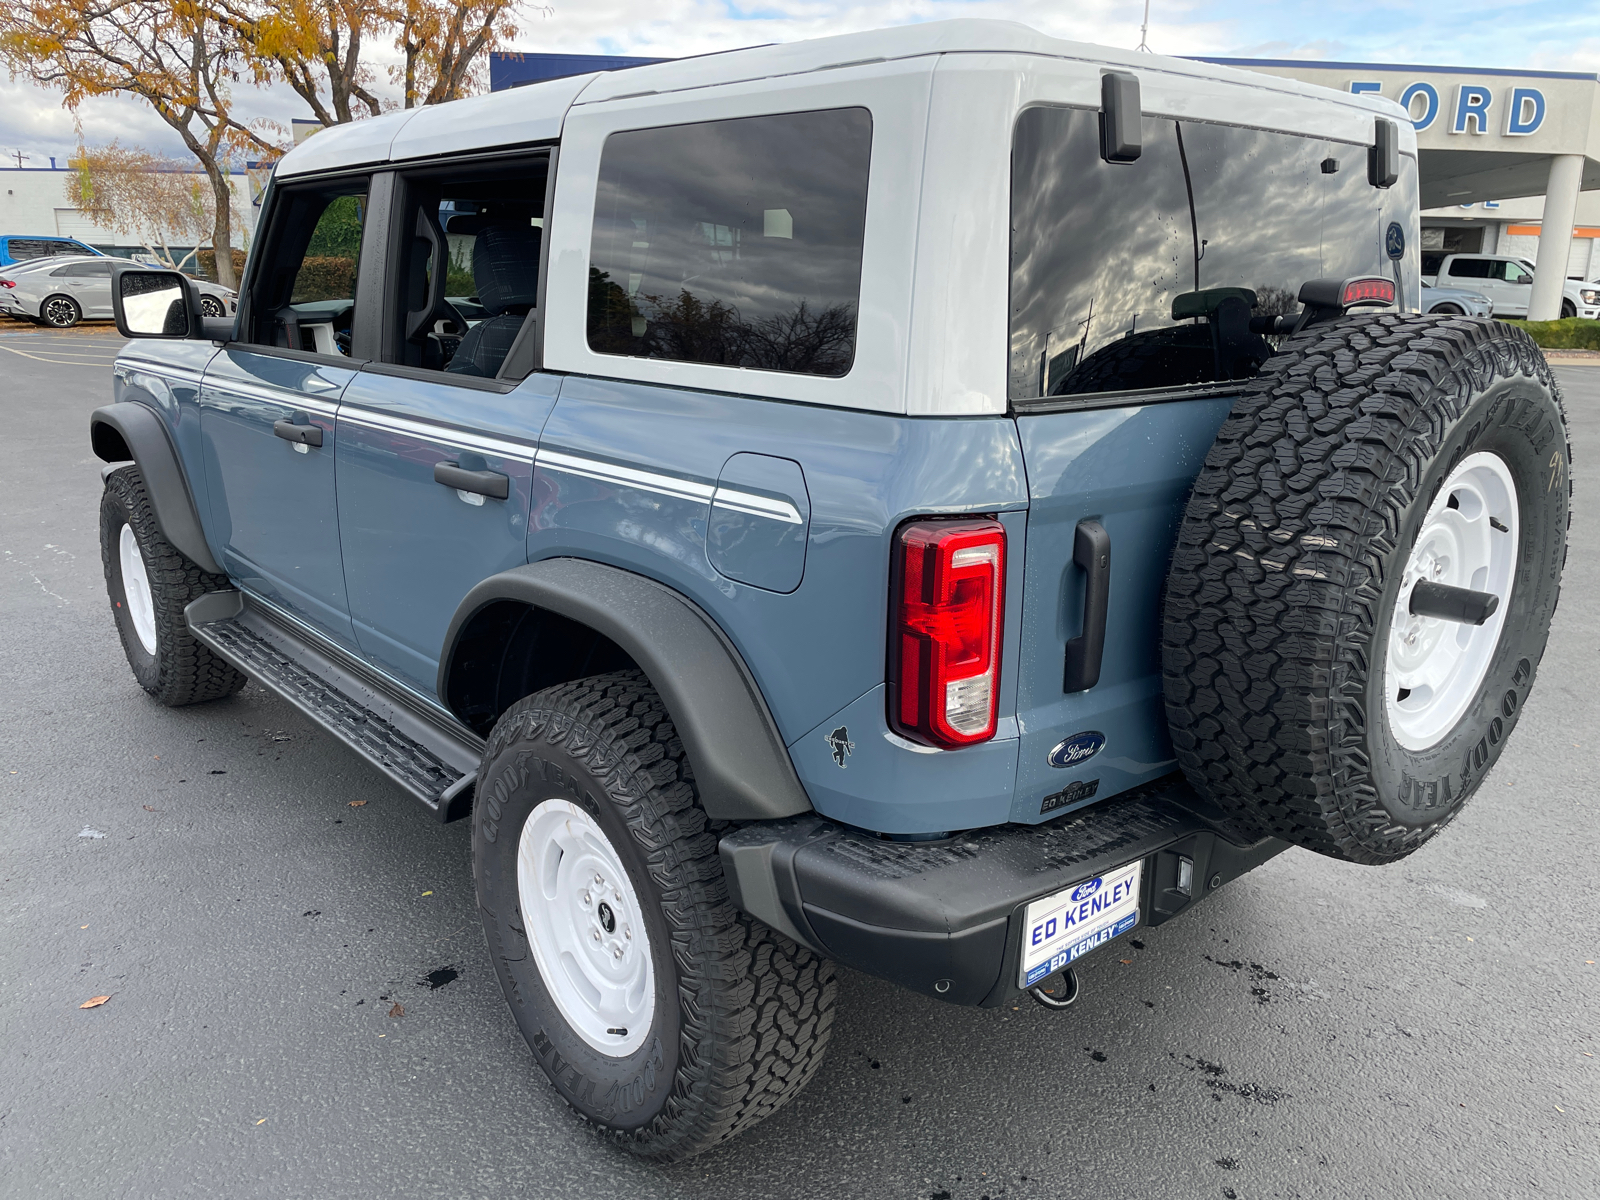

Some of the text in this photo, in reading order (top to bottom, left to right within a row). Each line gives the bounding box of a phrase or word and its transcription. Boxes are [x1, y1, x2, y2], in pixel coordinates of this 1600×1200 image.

[1349, 81, 1547, 136] ORD
[1064, 738, 1095, 762] Ford
[1032, 876, 1135, 946] ED KENLEY
[1076, 881, 1099, 901] Ford
[1050, 925, 1116, 972] ED KENLEY
